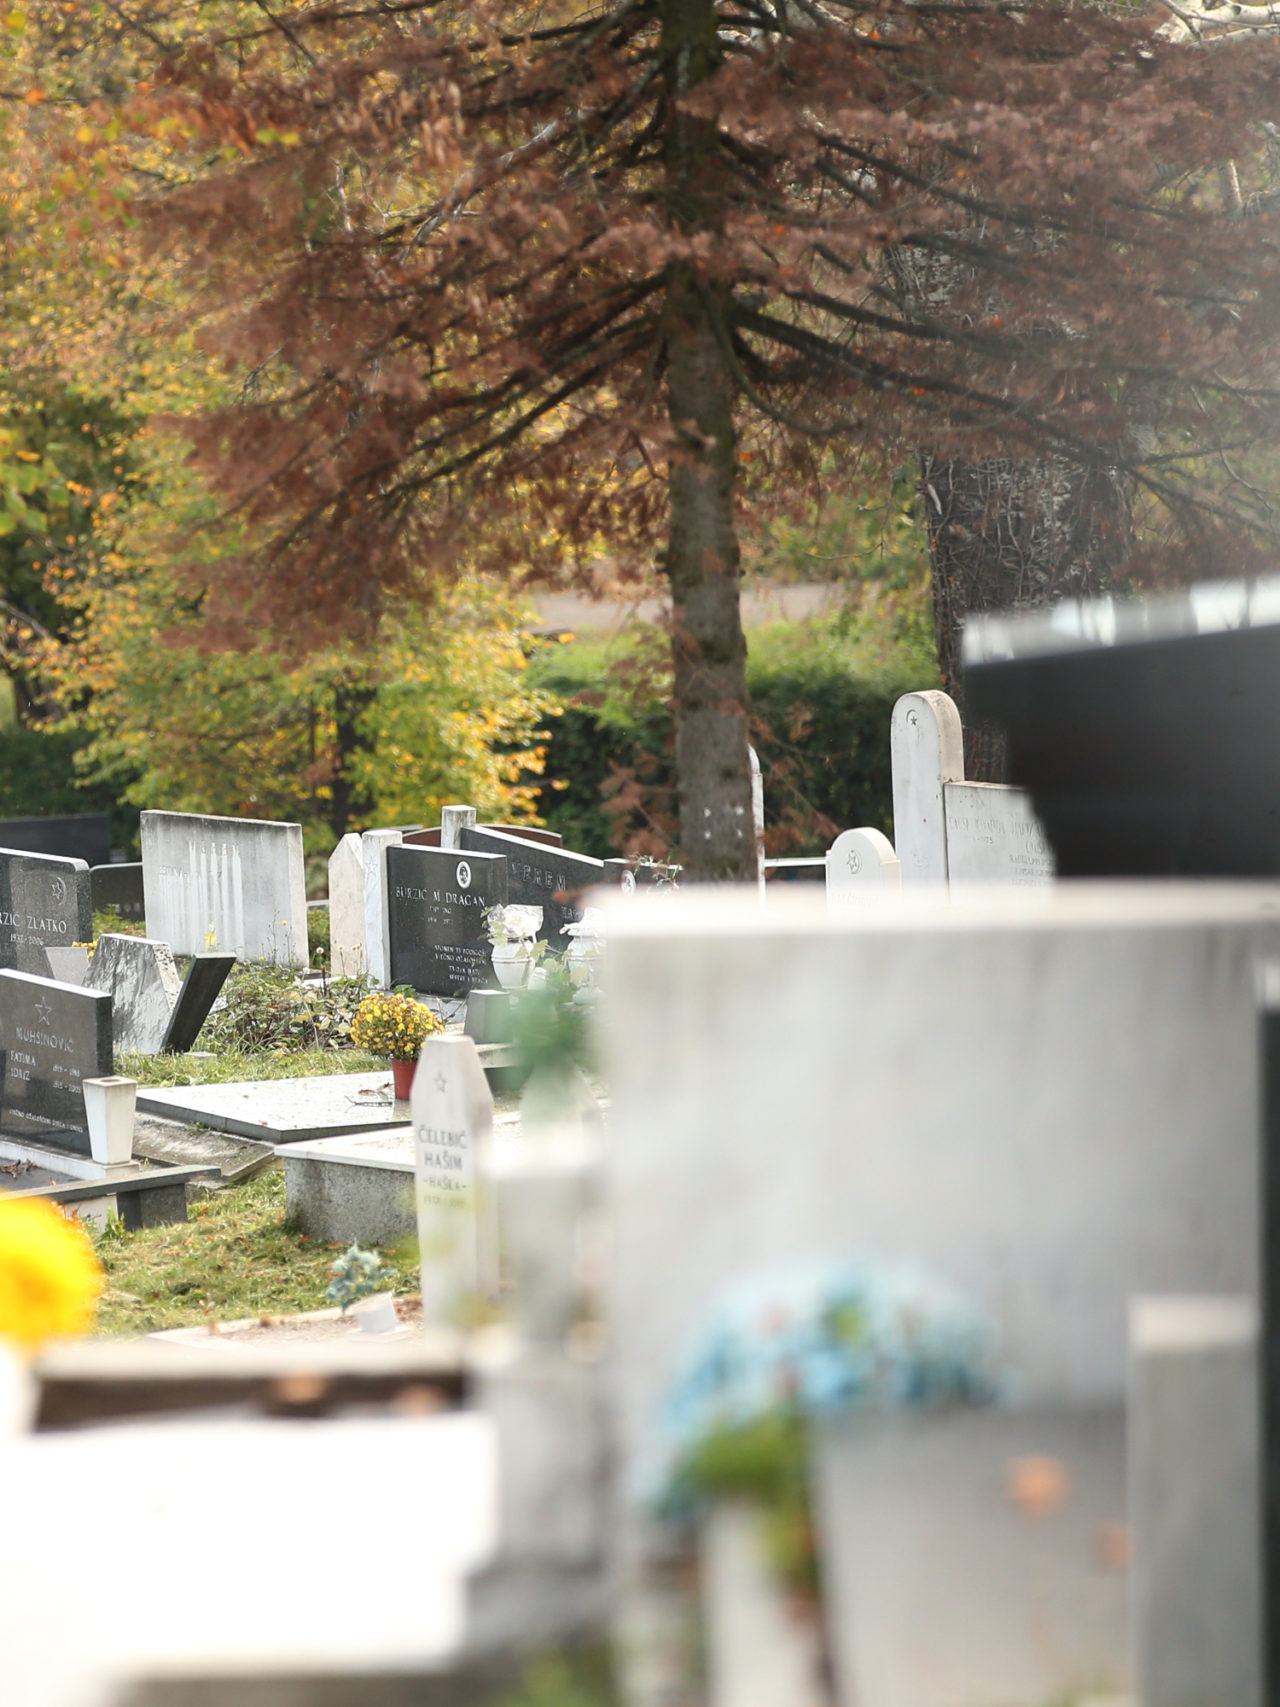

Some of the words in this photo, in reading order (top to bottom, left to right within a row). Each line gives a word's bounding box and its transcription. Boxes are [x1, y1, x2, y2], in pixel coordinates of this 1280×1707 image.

[445, 892, 485, 907] DRAGAN
[27, 915, 67, 934] ZLATKO
[10, 1050, 36, 1067] FATIMA
[424, 1149, 463, 1171] HAŠIM
